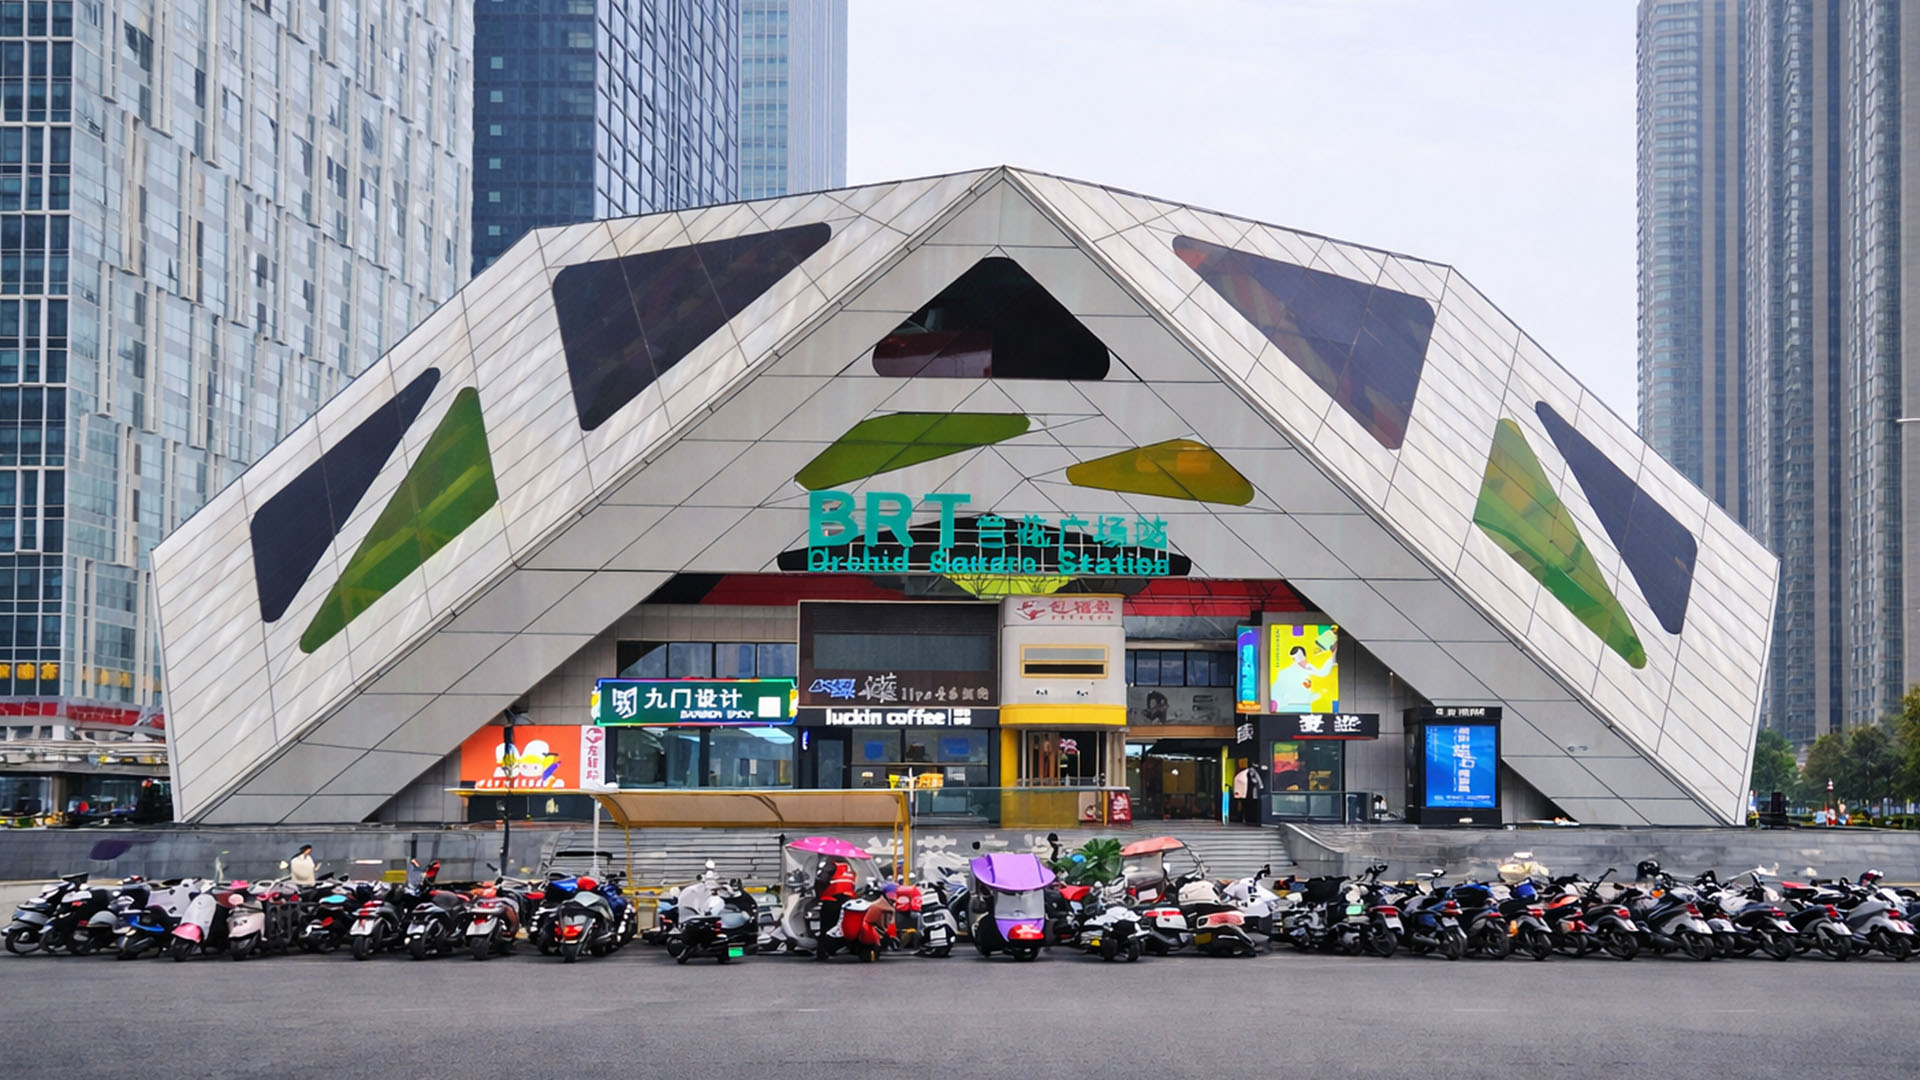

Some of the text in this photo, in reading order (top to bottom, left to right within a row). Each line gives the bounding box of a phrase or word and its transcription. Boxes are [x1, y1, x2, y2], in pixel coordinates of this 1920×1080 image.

[808, 490, 971, 549] BRT
[808, 548, 1170, 574] Orchid Square Station
[644, 687, 743, 709] 九门设计
[826, 708, 882, 725] luckin
[886, 708, 946, 725] coffee
